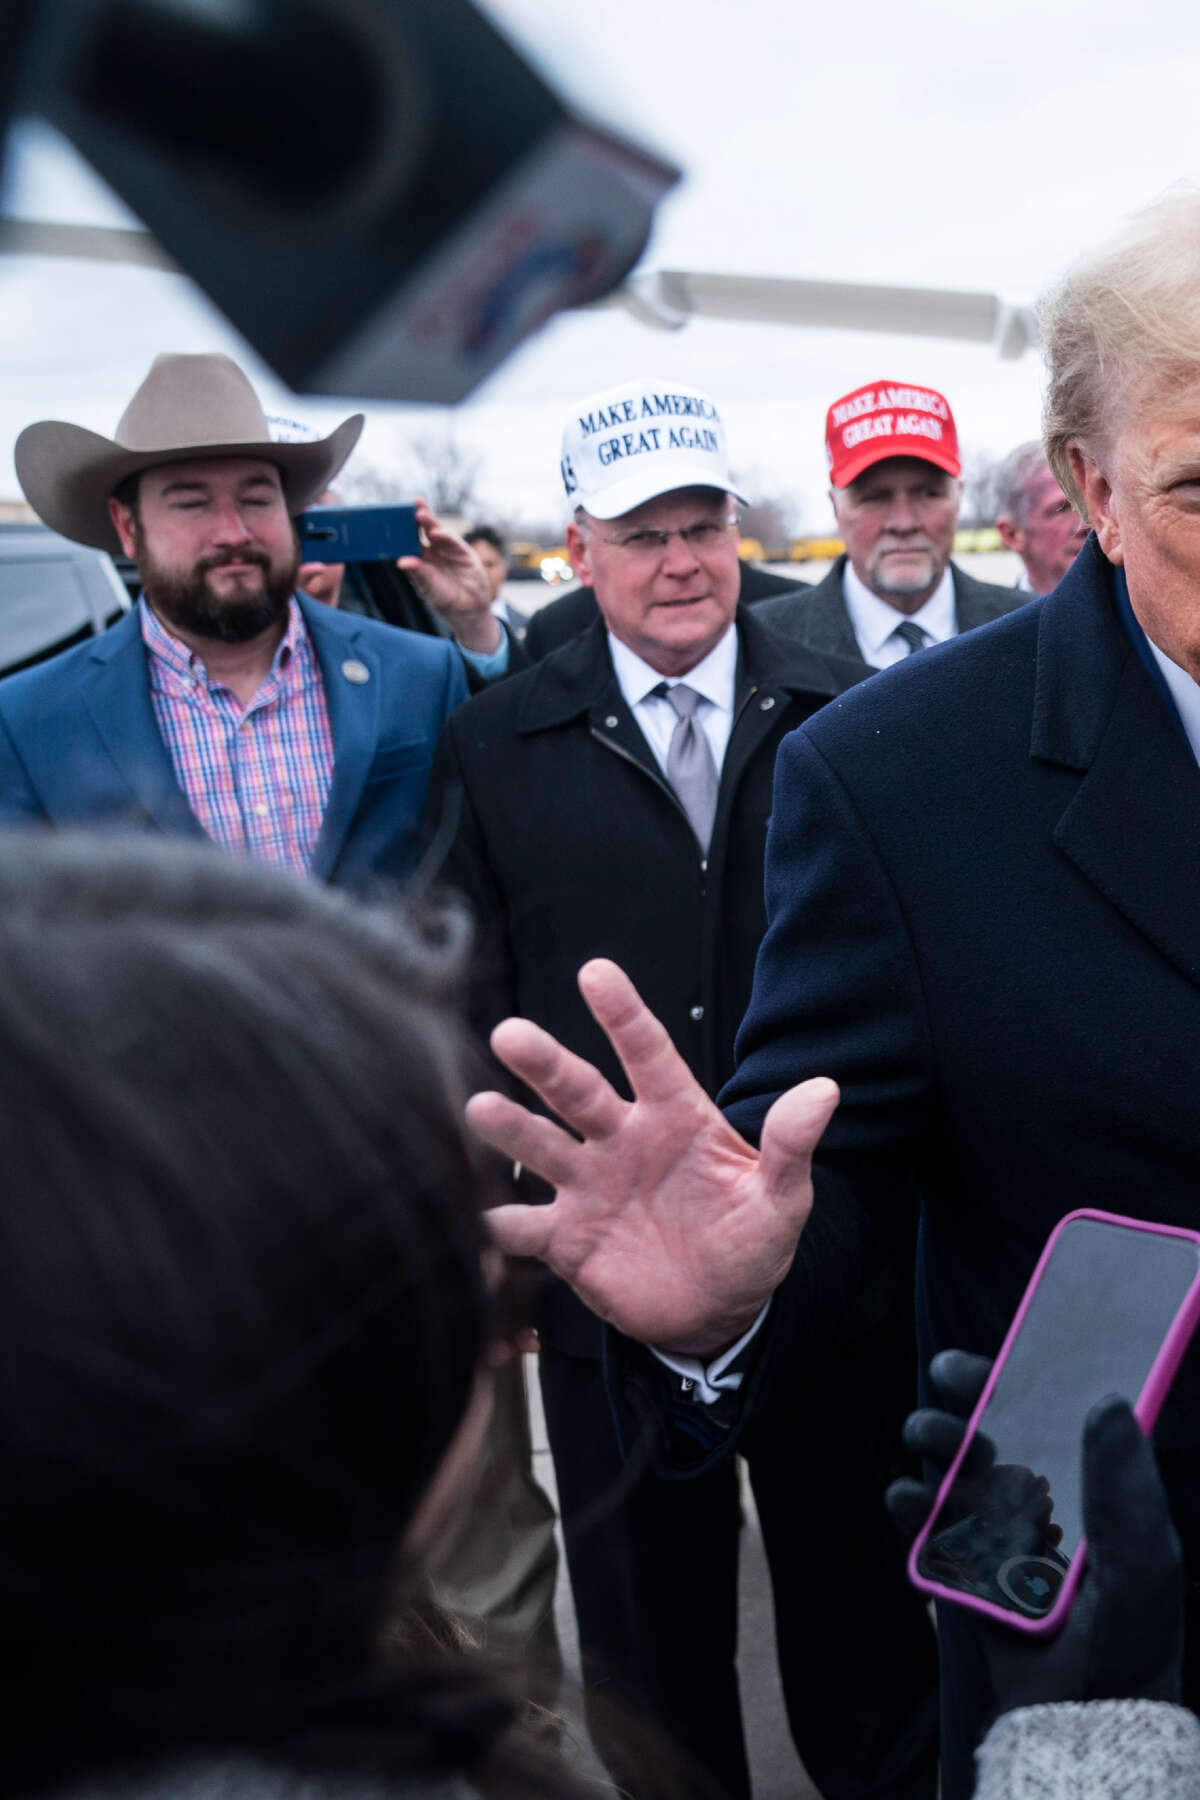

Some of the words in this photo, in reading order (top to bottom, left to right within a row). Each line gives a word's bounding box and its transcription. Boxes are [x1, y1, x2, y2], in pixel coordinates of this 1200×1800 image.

[579, 399, 637, 439] MAKE
[641, 394, 721, 423] AMERICA
[832, 390, 876, 428] MAKE
[878, 386, 949, 421] AMERICA
[598, 428, 661, 466] GREAT
[669, 426, 719, 454] AGAIN
[842, 414, 894, 449] GREAT
[895, 413, 943, 442] AGAIN
